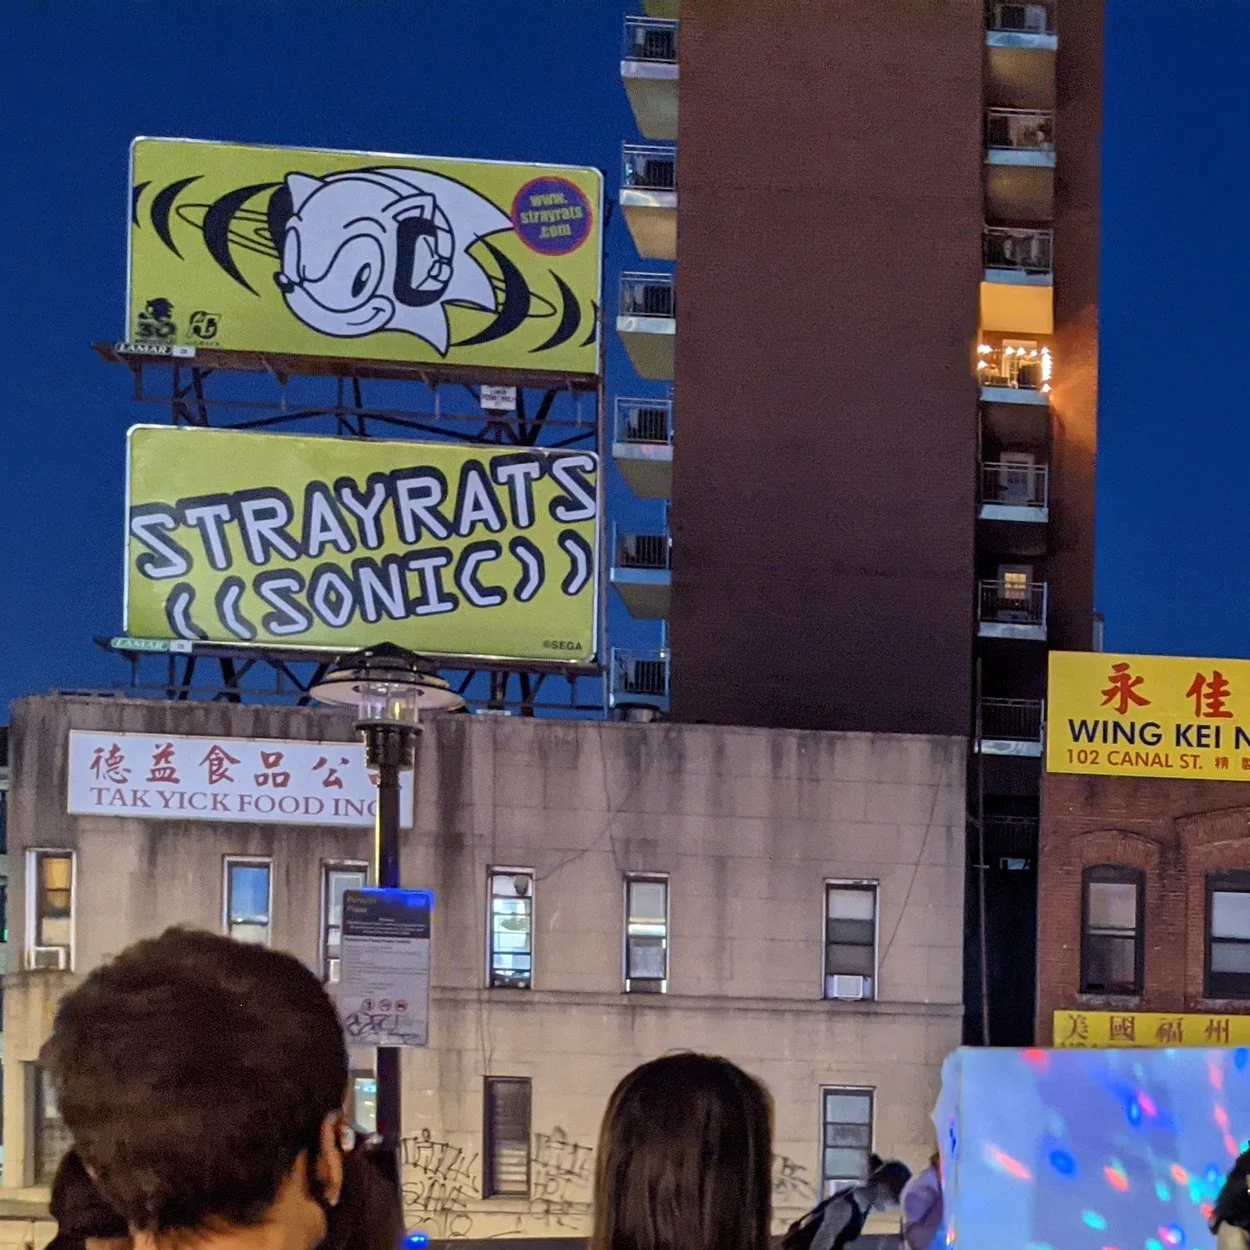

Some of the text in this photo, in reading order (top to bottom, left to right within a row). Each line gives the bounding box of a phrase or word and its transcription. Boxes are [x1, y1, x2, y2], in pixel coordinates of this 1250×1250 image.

[131, 452, 598, 580] STRAYRATS
[1068, 718, 1163, 746] WING
[1175, 723, 1221, 749] KEI
[90, 743, 402, 788] 德益食品公
[1067, 749, 1099, 765] 102
[1107, 750, 1173, 768] CANAL
[1179, 753, 1203, 769] ST.
[90, 787, 151, 807] TAK
[156, 790, 231, 812] YICK
[238, 794, 325, 817] FOOD
